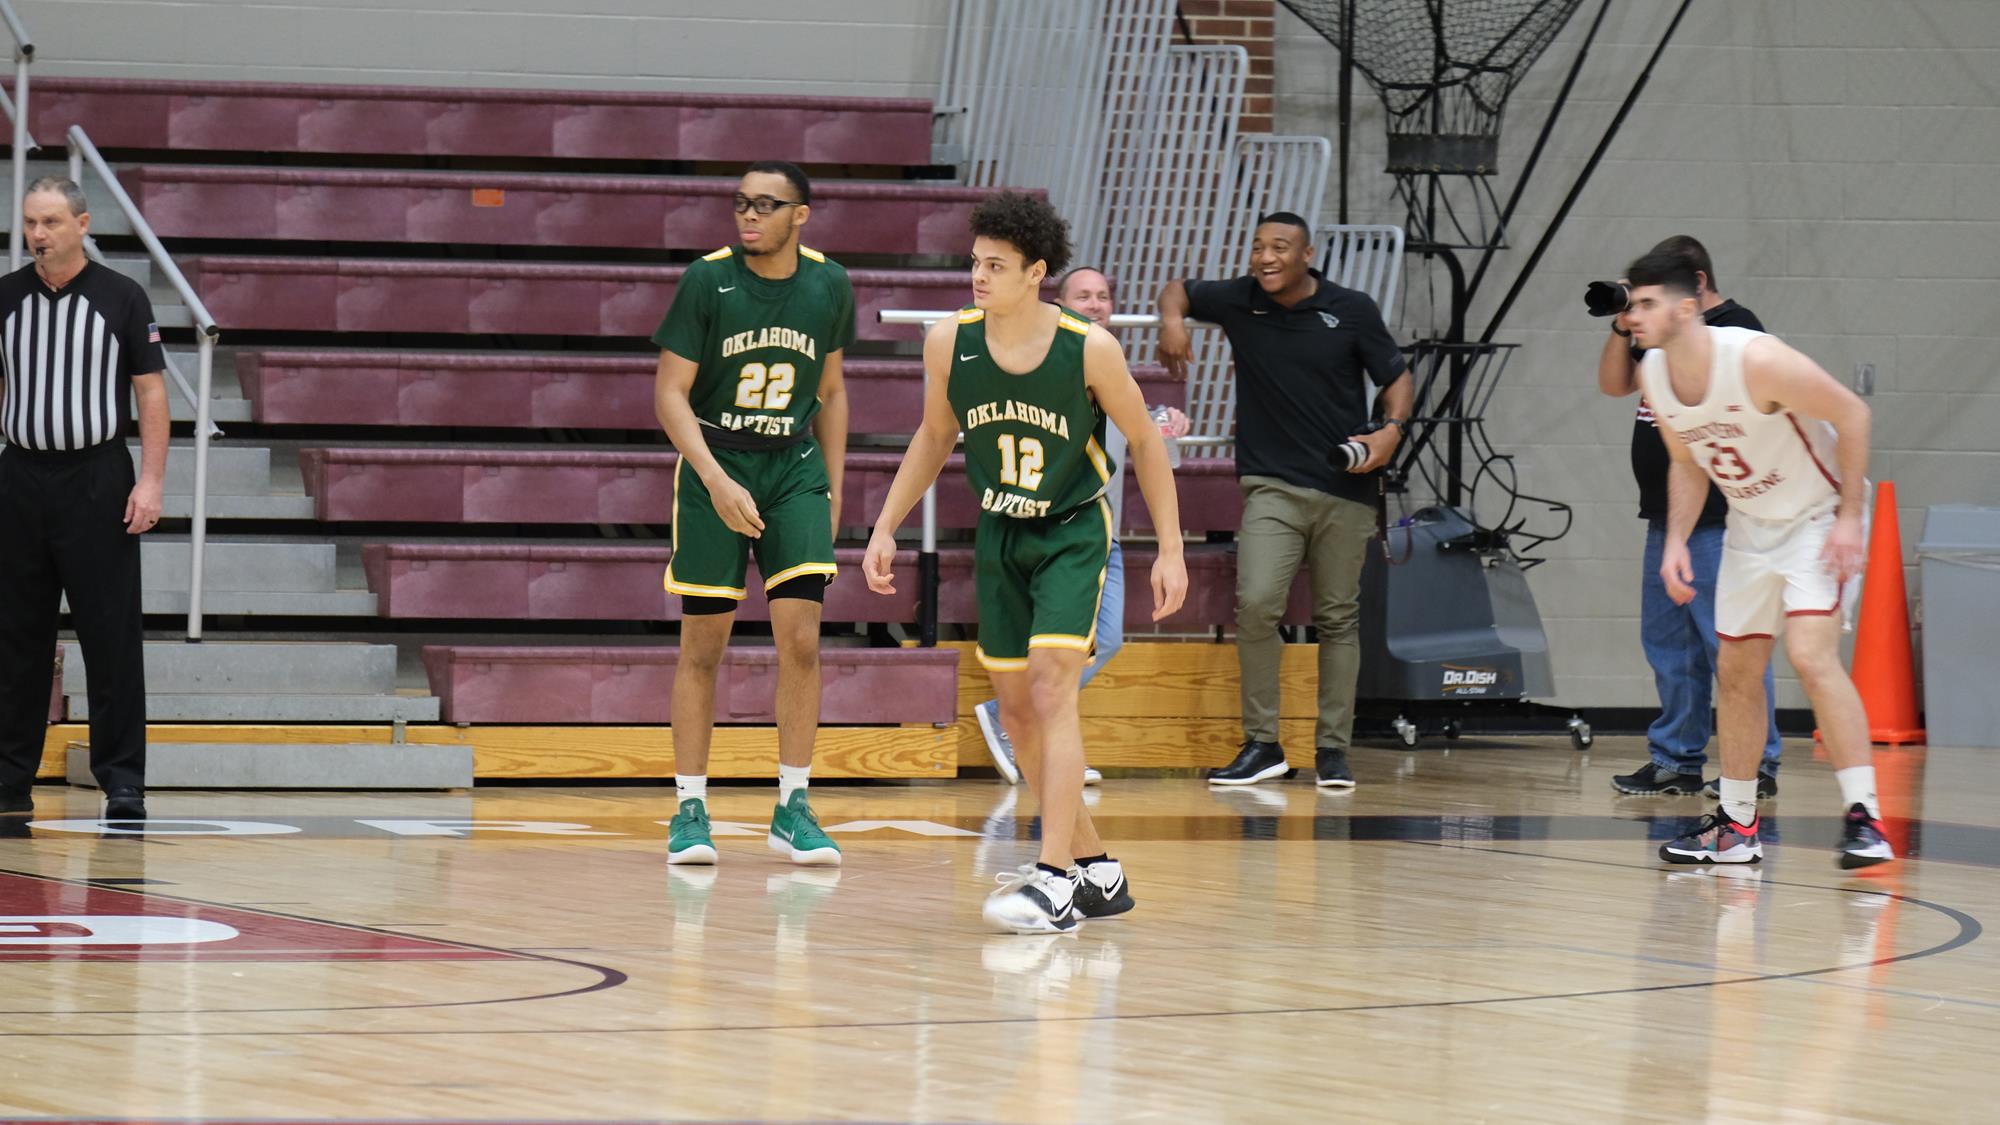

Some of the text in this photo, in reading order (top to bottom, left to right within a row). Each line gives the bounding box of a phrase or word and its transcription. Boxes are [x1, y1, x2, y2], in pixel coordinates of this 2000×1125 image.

[722, 326, 816, 361] OKLAHOMA
[735, 362, 796, 410] 22
[720, 411, 794, 436] BAPTIST
[967, 399, 1069, 441] OKLAHOMA
[997, 433, 1044, 492] 12
[981, 487, 1051, 519] BAPTIST
